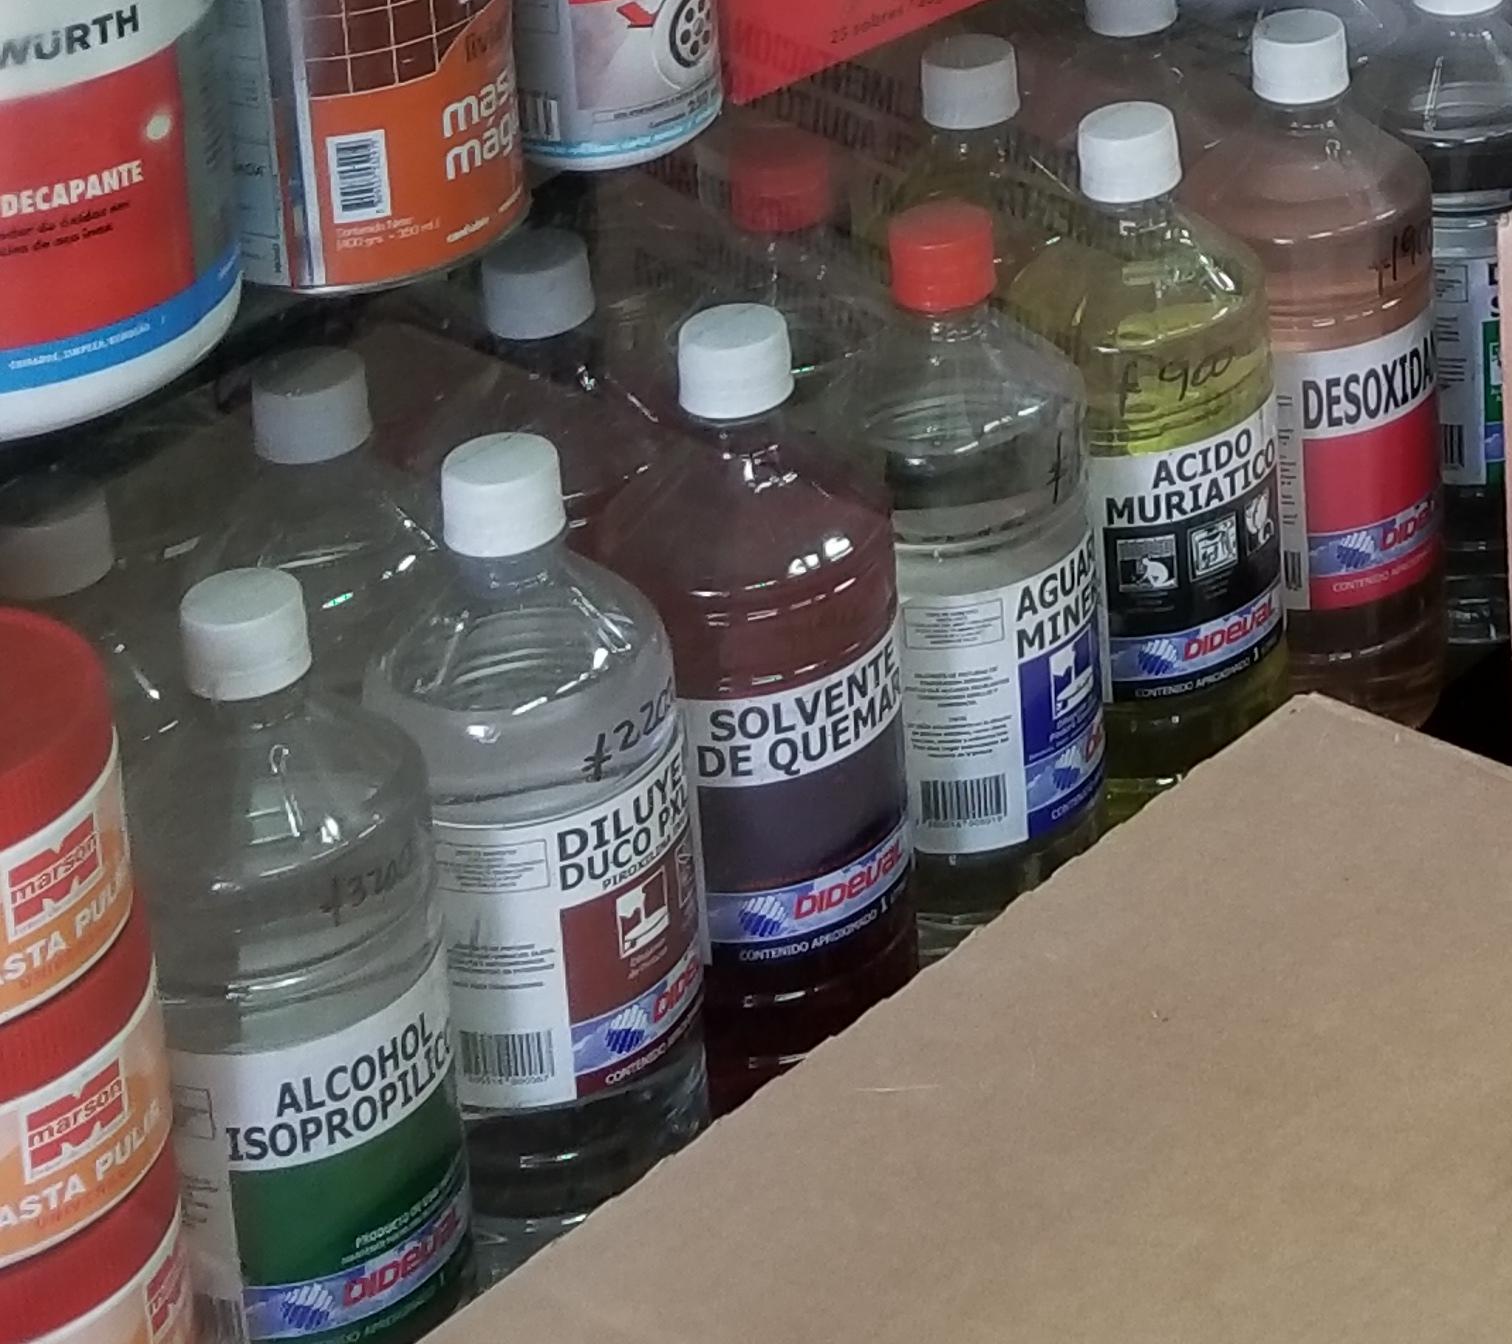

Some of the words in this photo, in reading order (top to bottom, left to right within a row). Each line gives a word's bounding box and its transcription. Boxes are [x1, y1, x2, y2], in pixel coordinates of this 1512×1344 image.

[0, 158, 145, 218] DECAPANTE
[1105, 438, 1276, 527] MURIATICO
[1151, 427, 1253, 491] ACIDO
[710, 637, 897, 743] SOLVENTE
[1135, 681, 1194, 700] CONTENIDO
[697, 743, 753, 778] DE
[556, 752, 684, 863] DILUYE
[10, 832, 98, 901] marson
[560, 826, 652, 892] DUCO
[739, 940, 809, 963] CONTENIDO
[275, 1012, 433, 1118] ALCOHOL
[28, 1078, 124, 1149] marson
